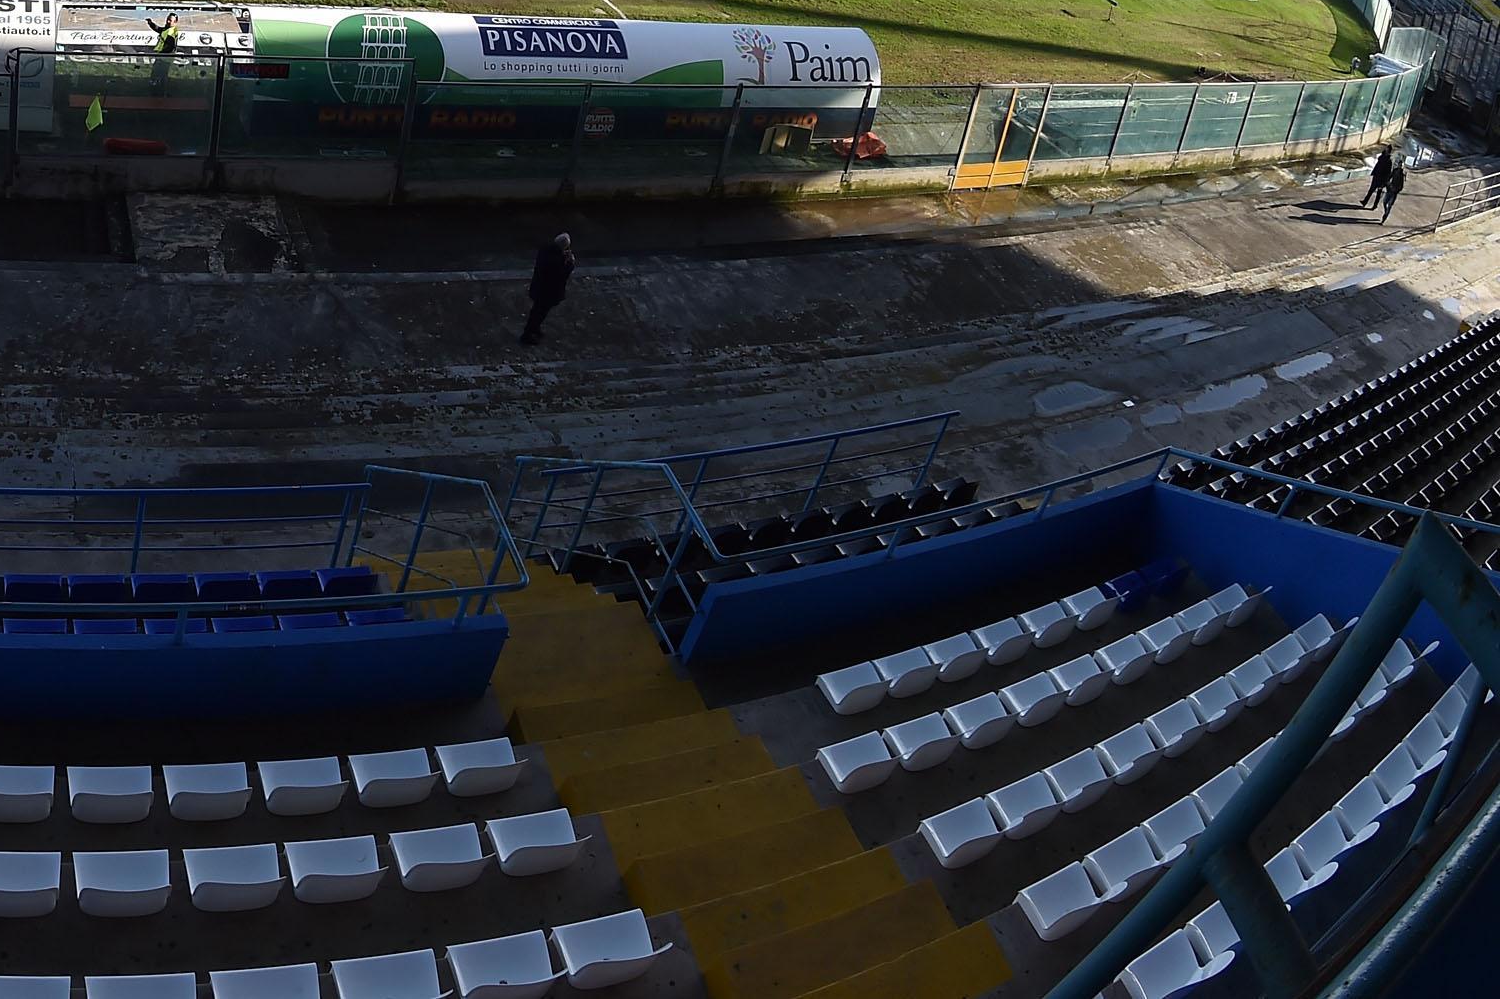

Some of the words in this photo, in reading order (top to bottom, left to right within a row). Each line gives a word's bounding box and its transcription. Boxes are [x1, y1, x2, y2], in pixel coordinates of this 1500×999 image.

[17, 15, 50, 24] 1965
[492, 17, 531, 25] CENTRO
[533, 18, 601, 27] COMMERCIALE
[486, 30, 621, 54] PISANOVA
[484, 61, 496, 70] Lo
[501, 61, 553, 74] shopping
[557, 64, 581, 72] tutti
[593, 64, 624, 74] giorni
[783, 40, 874, 83] Paim
[318, 106, 406, 127] PUNT
